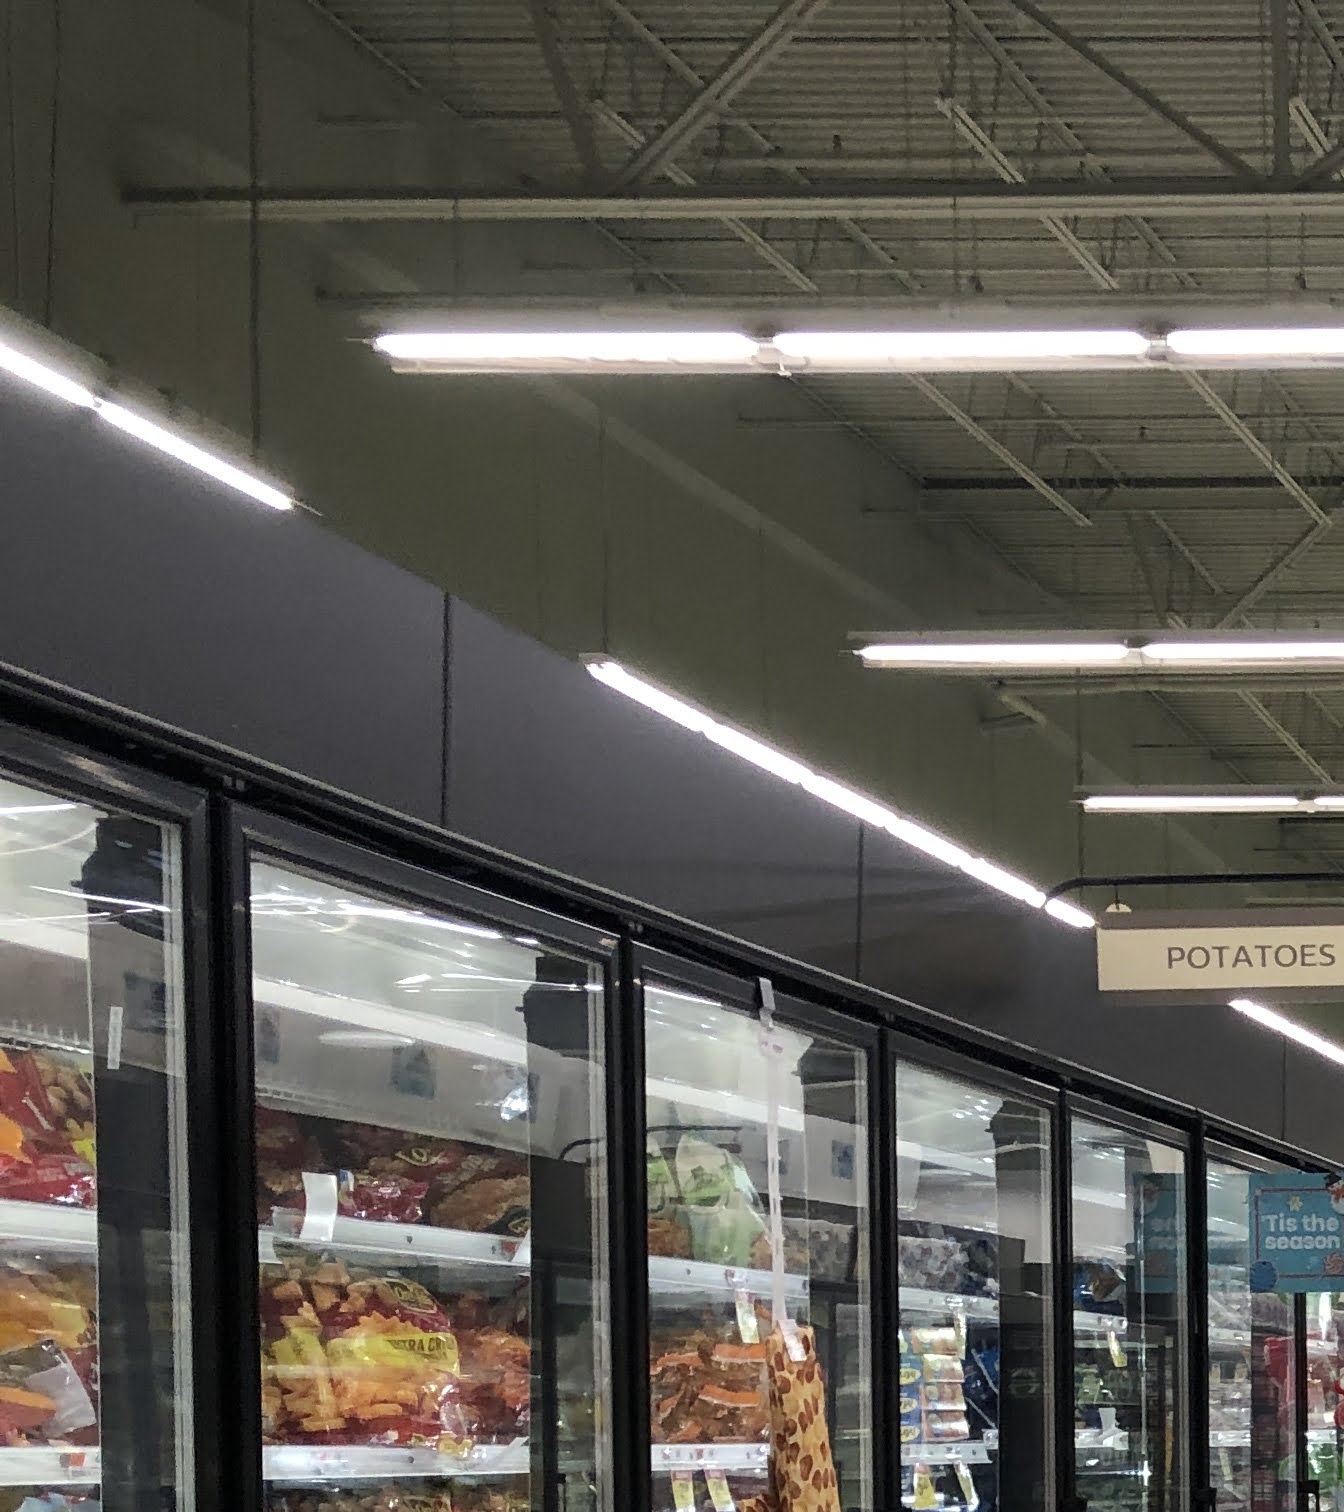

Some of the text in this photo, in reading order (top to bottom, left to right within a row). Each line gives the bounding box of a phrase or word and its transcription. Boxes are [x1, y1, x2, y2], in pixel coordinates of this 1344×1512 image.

[1166, 943, 1337, 969] POTATOES
[1302, 1213, 1340, 1232] the
[1264, 1234, 1341, 1250] season
